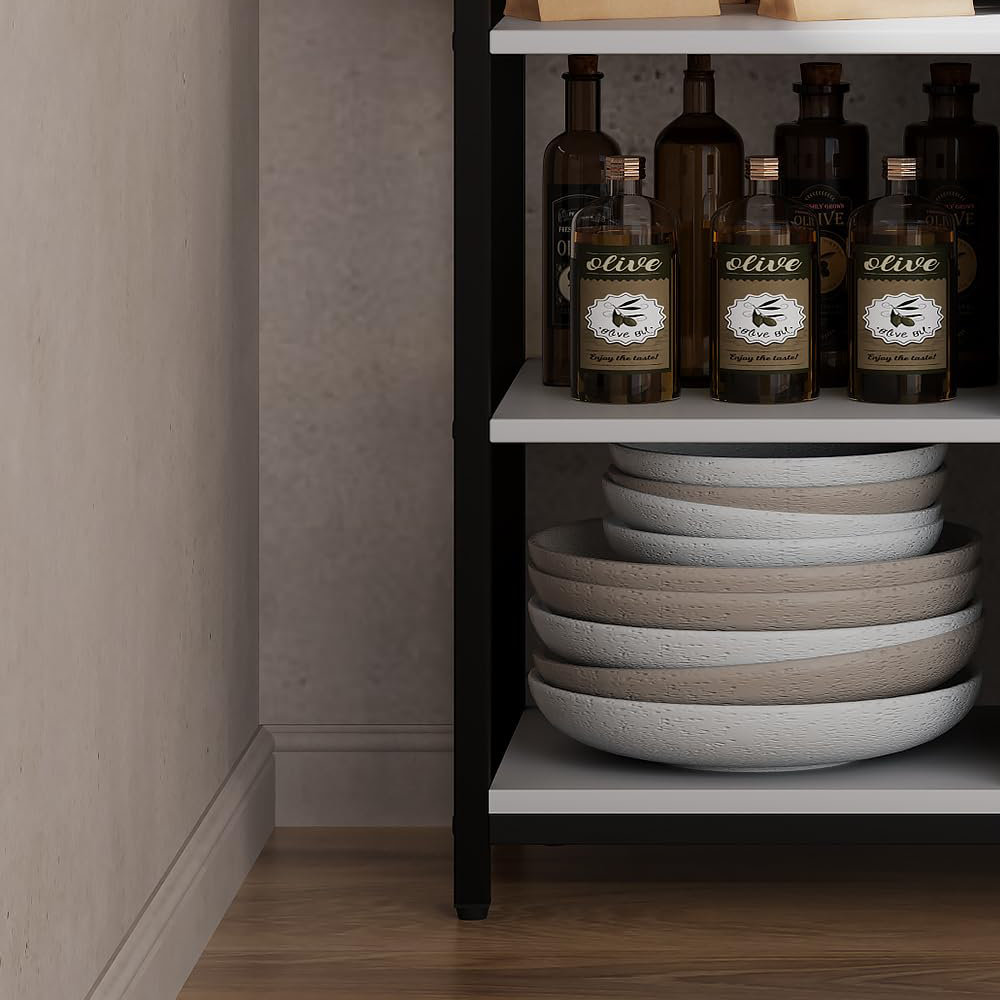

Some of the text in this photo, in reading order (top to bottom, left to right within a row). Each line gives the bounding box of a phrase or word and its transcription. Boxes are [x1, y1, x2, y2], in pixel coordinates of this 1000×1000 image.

[586, 255, 663, 272] olive
[726, 255, 803, 272] olive
[864, 255, 940, 272] olive
[590, 353, 614, 362] Enjoy
[633, 353, 659, 361] taste!
[729, 353, 754, 362] Enjoy
[773, 353, 799, 361] taste!
[867, 353, 892, 362] Enjoy
[911, 353, 937, 361] taste!
